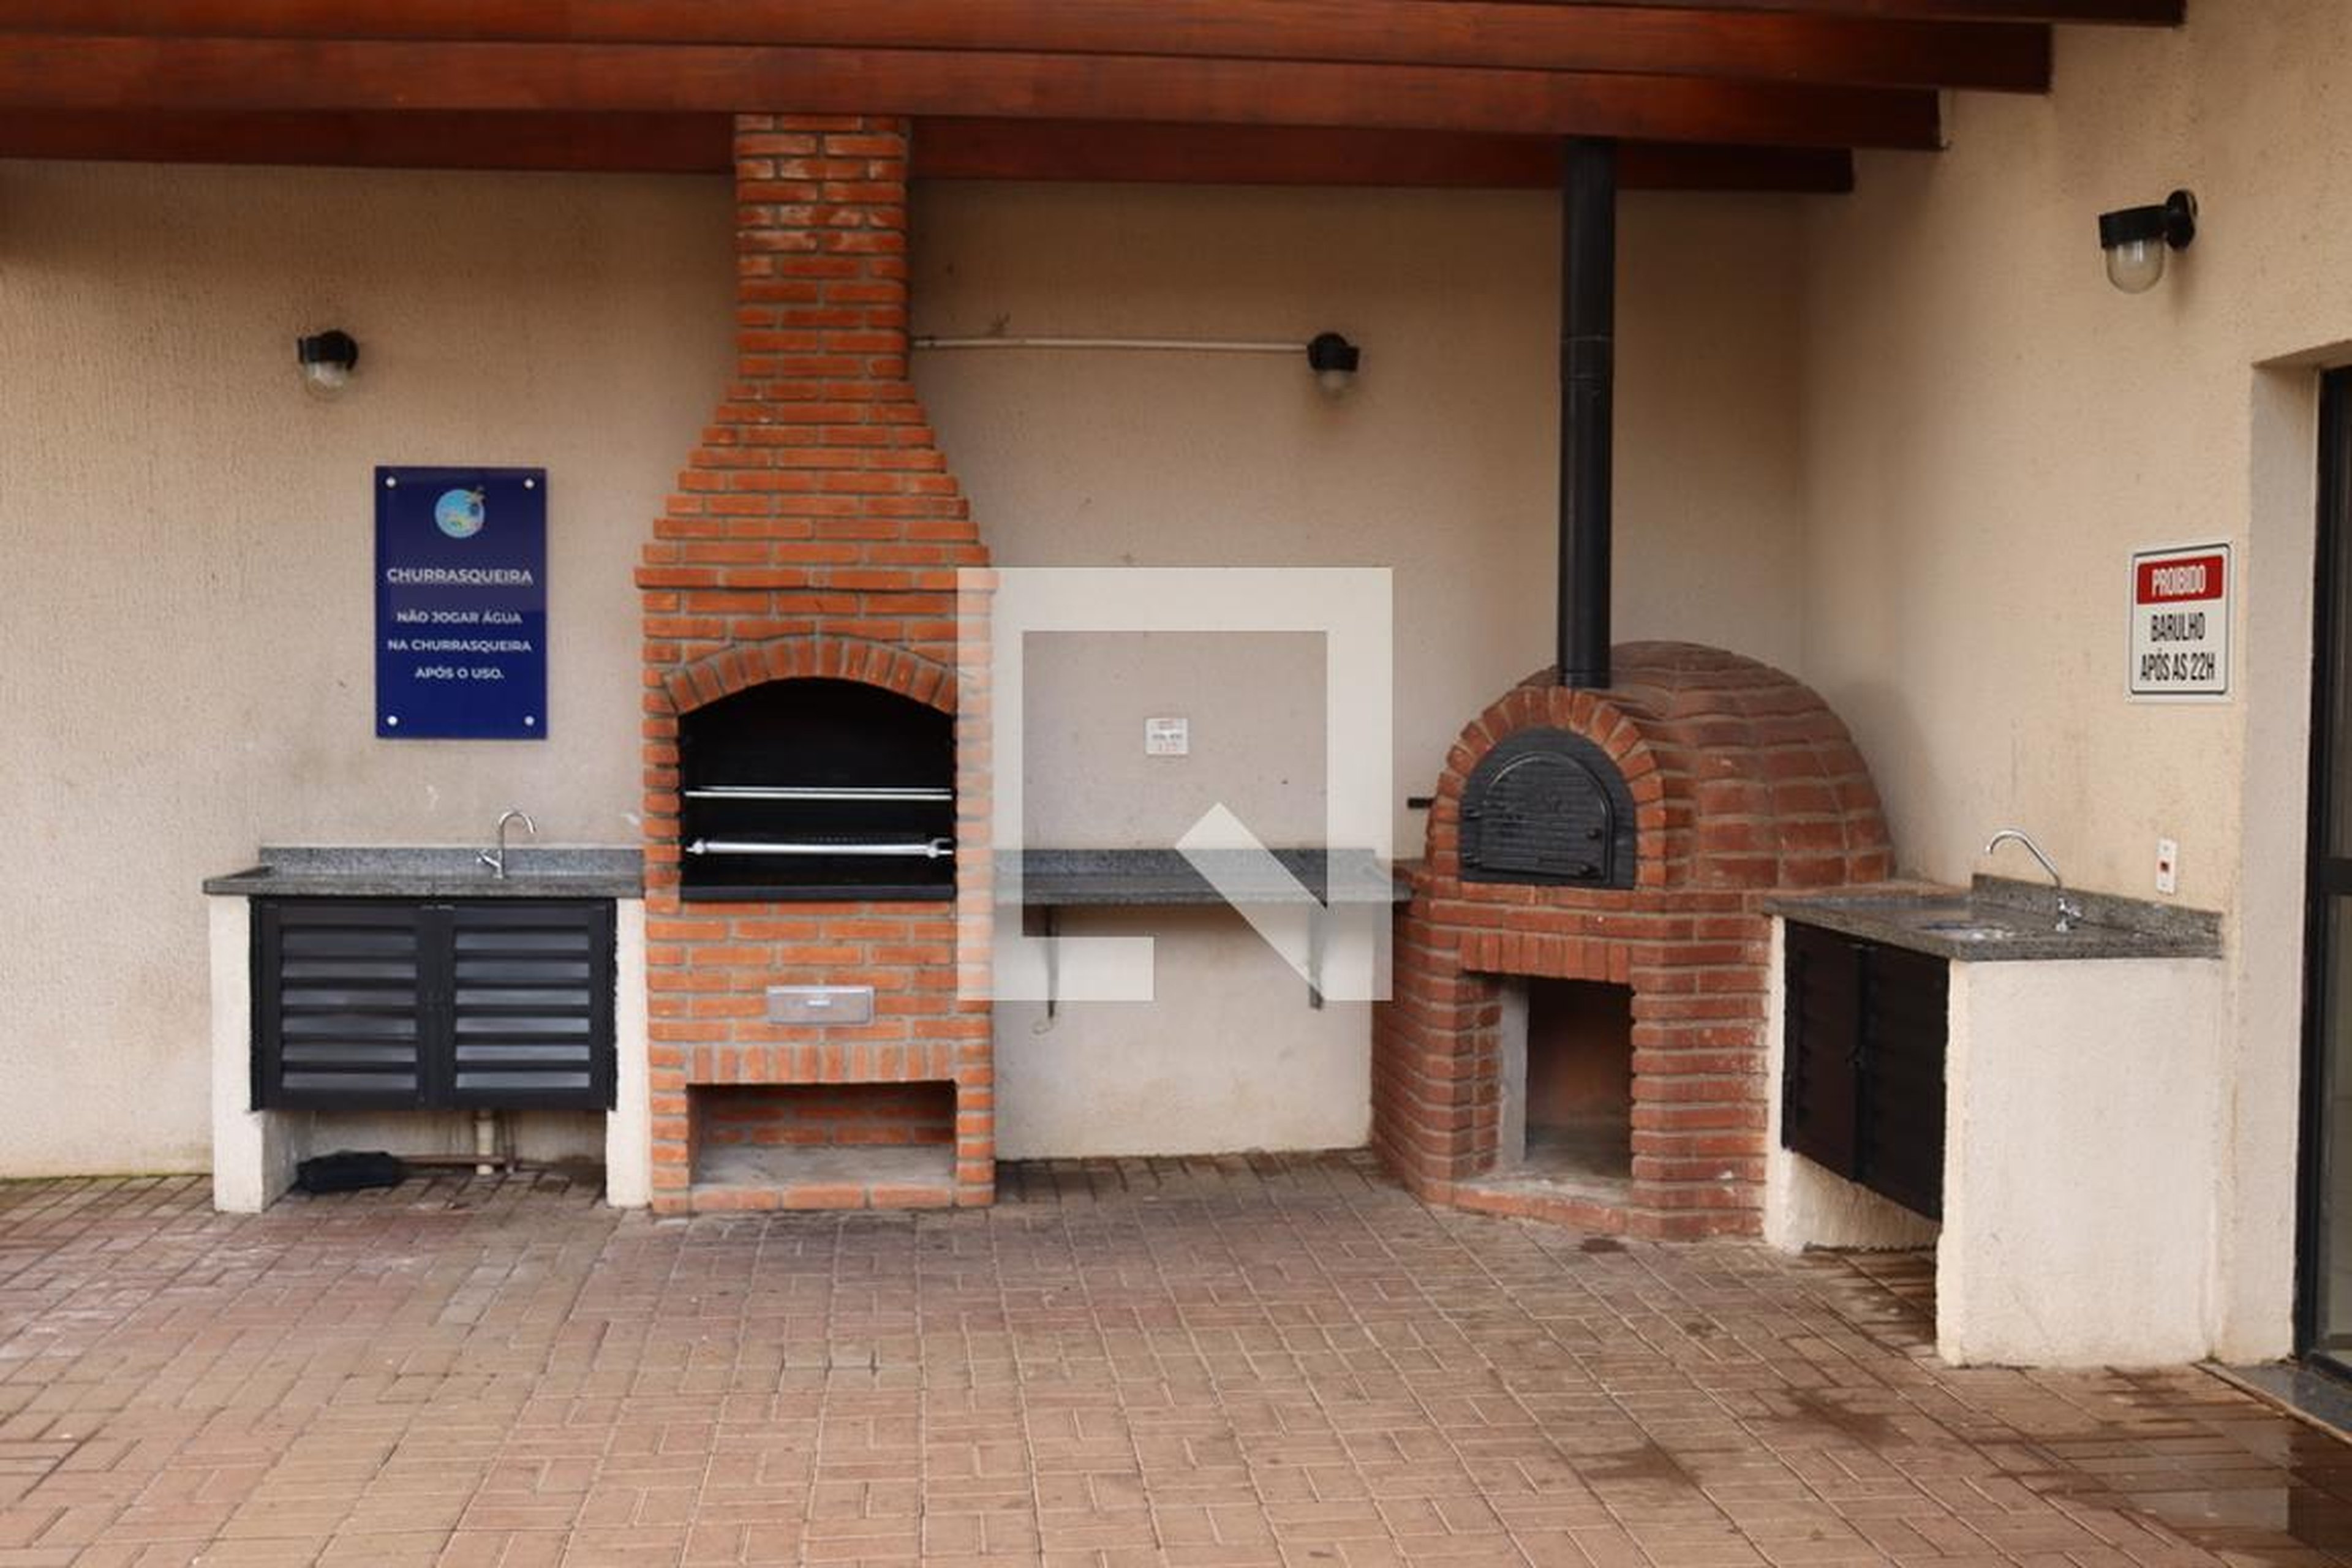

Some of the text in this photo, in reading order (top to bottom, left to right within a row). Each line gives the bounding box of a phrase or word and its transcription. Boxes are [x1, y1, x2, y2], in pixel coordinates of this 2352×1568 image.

[386, 568, 534, 586] CHURRASQUEIRA
[397, 609, 523, 624] NÃO JOGAR ÁGUA
[2152, 612, 2205, 641] BARULHO
[388, 639, 532, 653] NA CHURRASQUEIRA
[415, 666, 454, 679] APÓS
[457, 668, 469, 679] O
[2191, 652, 2215, 680] 22H
